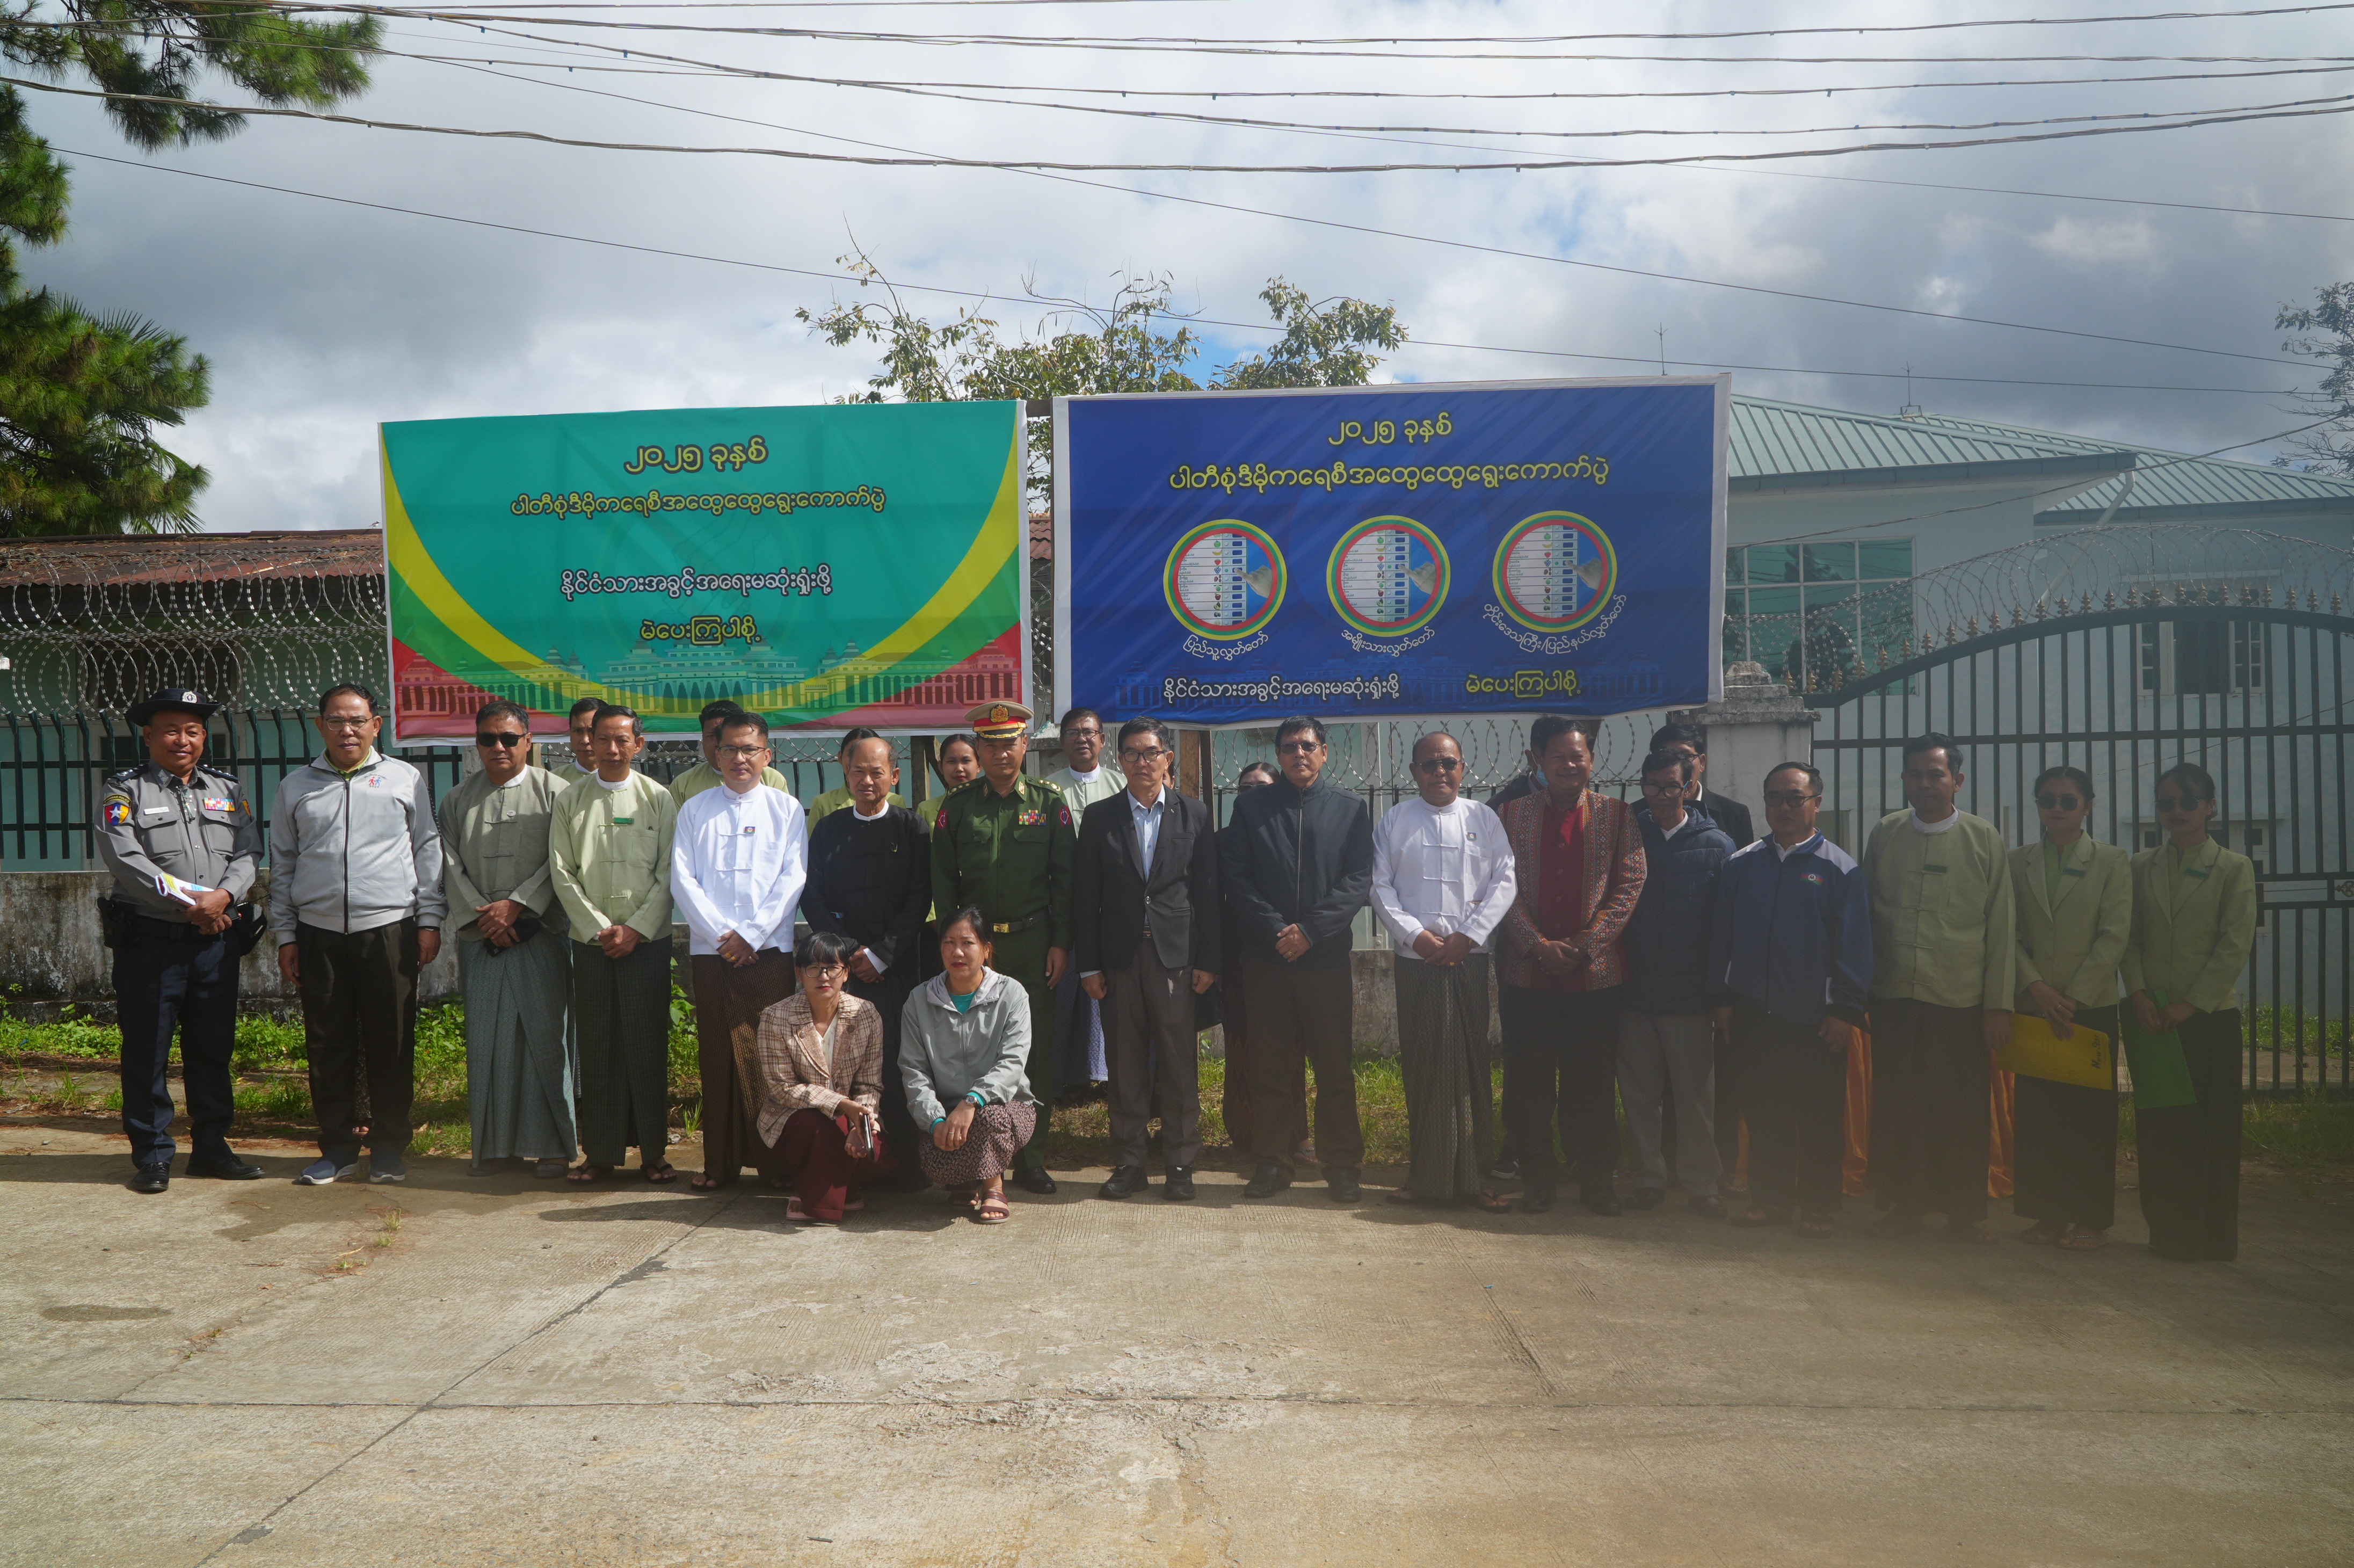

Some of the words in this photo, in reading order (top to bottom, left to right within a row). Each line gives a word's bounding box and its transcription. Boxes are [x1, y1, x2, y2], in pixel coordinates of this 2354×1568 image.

[1328, 420, 1396, 446] ၂၀၂၅
[1404, 411, 1453, 444] ခုနှစ်
[626, 446, 702, 473] ၂၀၂၅
[711, 437, 768, 471] ခုနှစ်
[641, 615, 760, 644] မဲပေးကြပါစို့
[1341, 626, 1436, 658] အမျိုးသားလွှတ်တော်
[1182, 630, 1269, 661] ပြည်သူ့လွှတ်တော်
[1466, 669, 1581, 698] မဲပေးကြပါစို့
